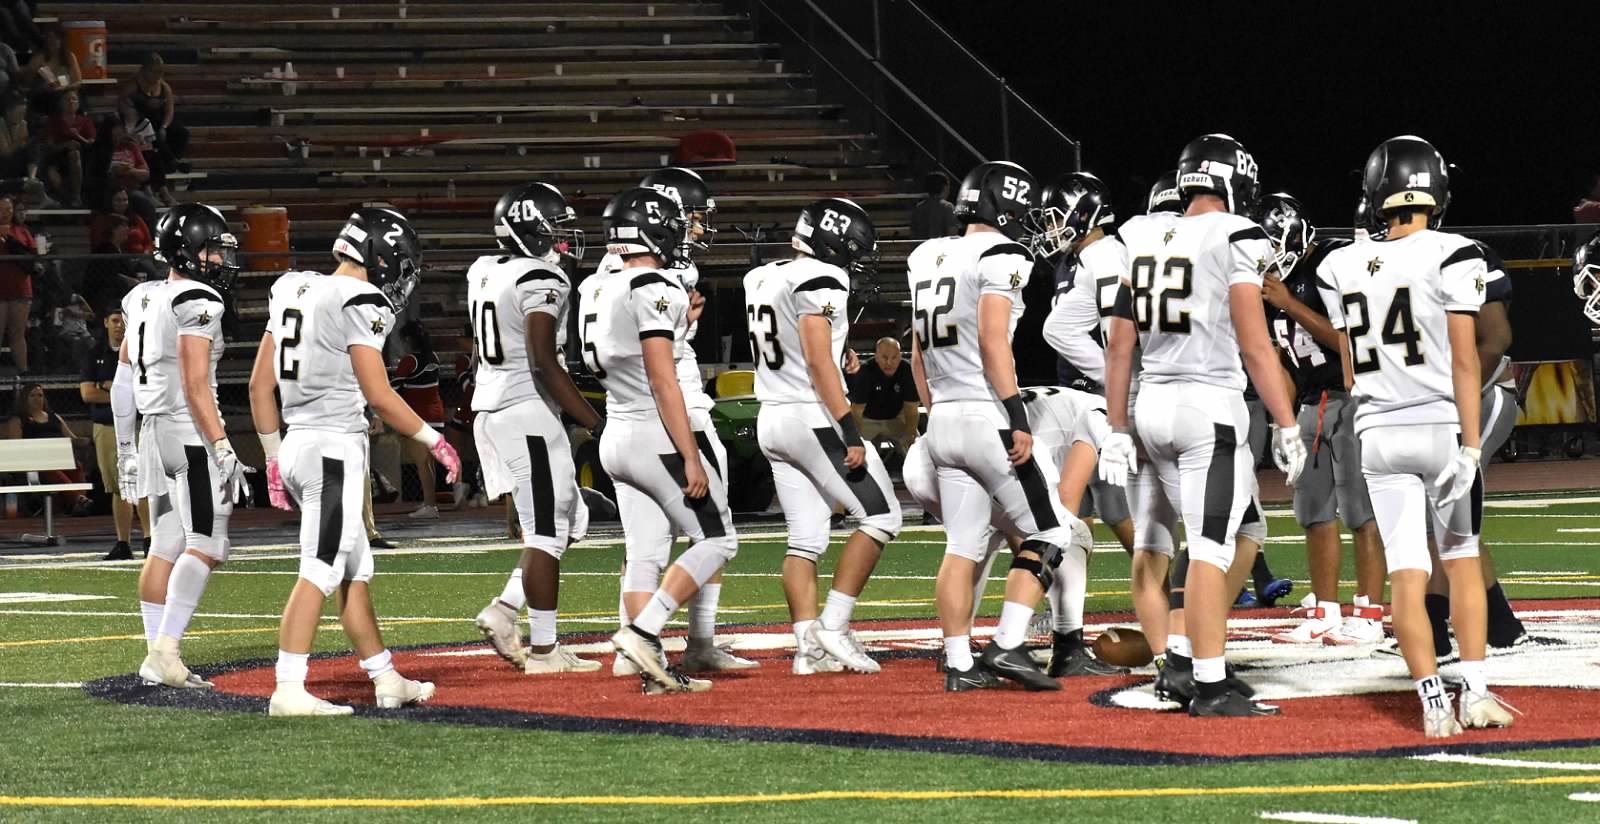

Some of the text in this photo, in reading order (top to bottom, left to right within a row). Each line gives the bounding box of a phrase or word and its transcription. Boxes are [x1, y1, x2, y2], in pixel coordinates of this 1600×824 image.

[507, 200, 537, 223] 40
[645, 201, 661, 224] 5
[1002, 175, 1032, 205] 52
[382, 222, 404, 247] 2
[819, 208, 852, 235] 63
[914, 276, 960, 350] 52
[1131, 256, 1193, 335] 82
[138, 321, 148, 385] 1
[279, 307, 303, 381] 2
[1342, 284, 1426, 375] 24
